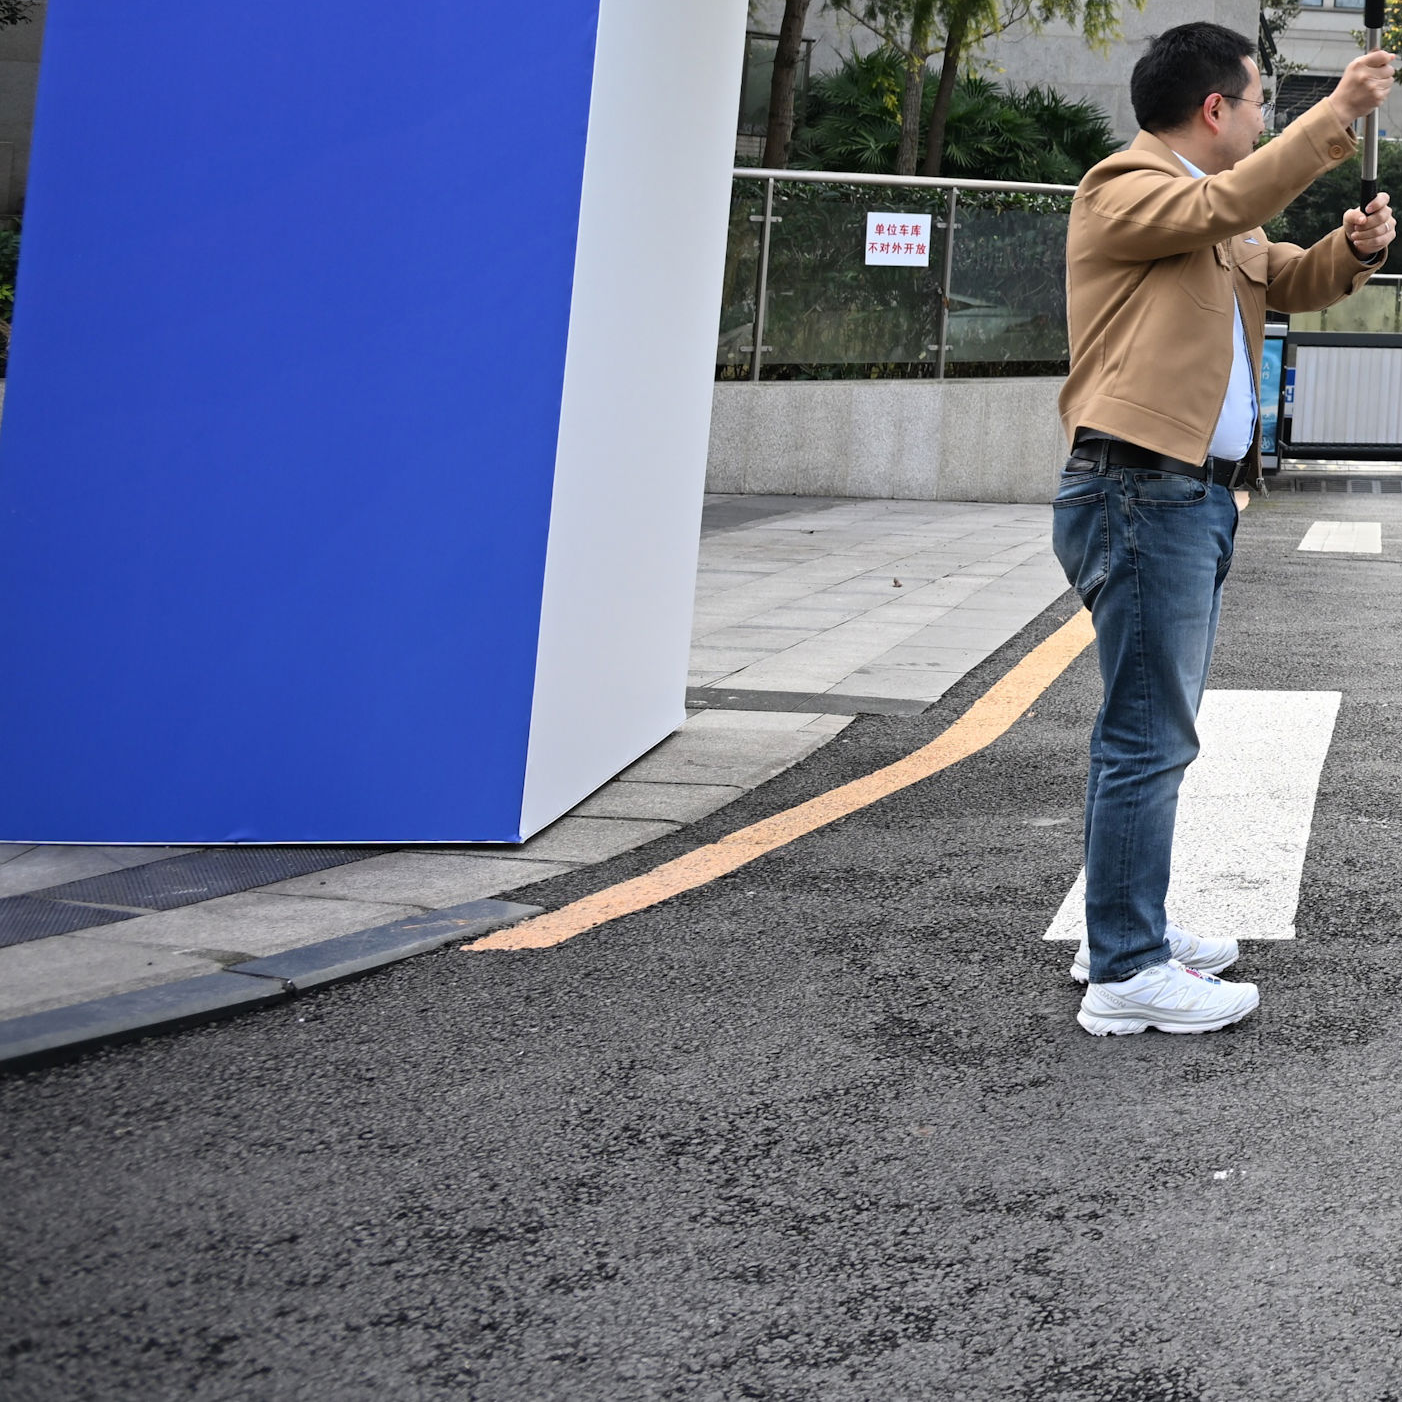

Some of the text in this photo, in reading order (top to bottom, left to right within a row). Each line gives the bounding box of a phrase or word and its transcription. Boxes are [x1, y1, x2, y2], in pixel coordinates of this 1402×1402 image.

[875, 223, 921, 236] 单位车库
[868, 242, 926, 255] 不对外开放
